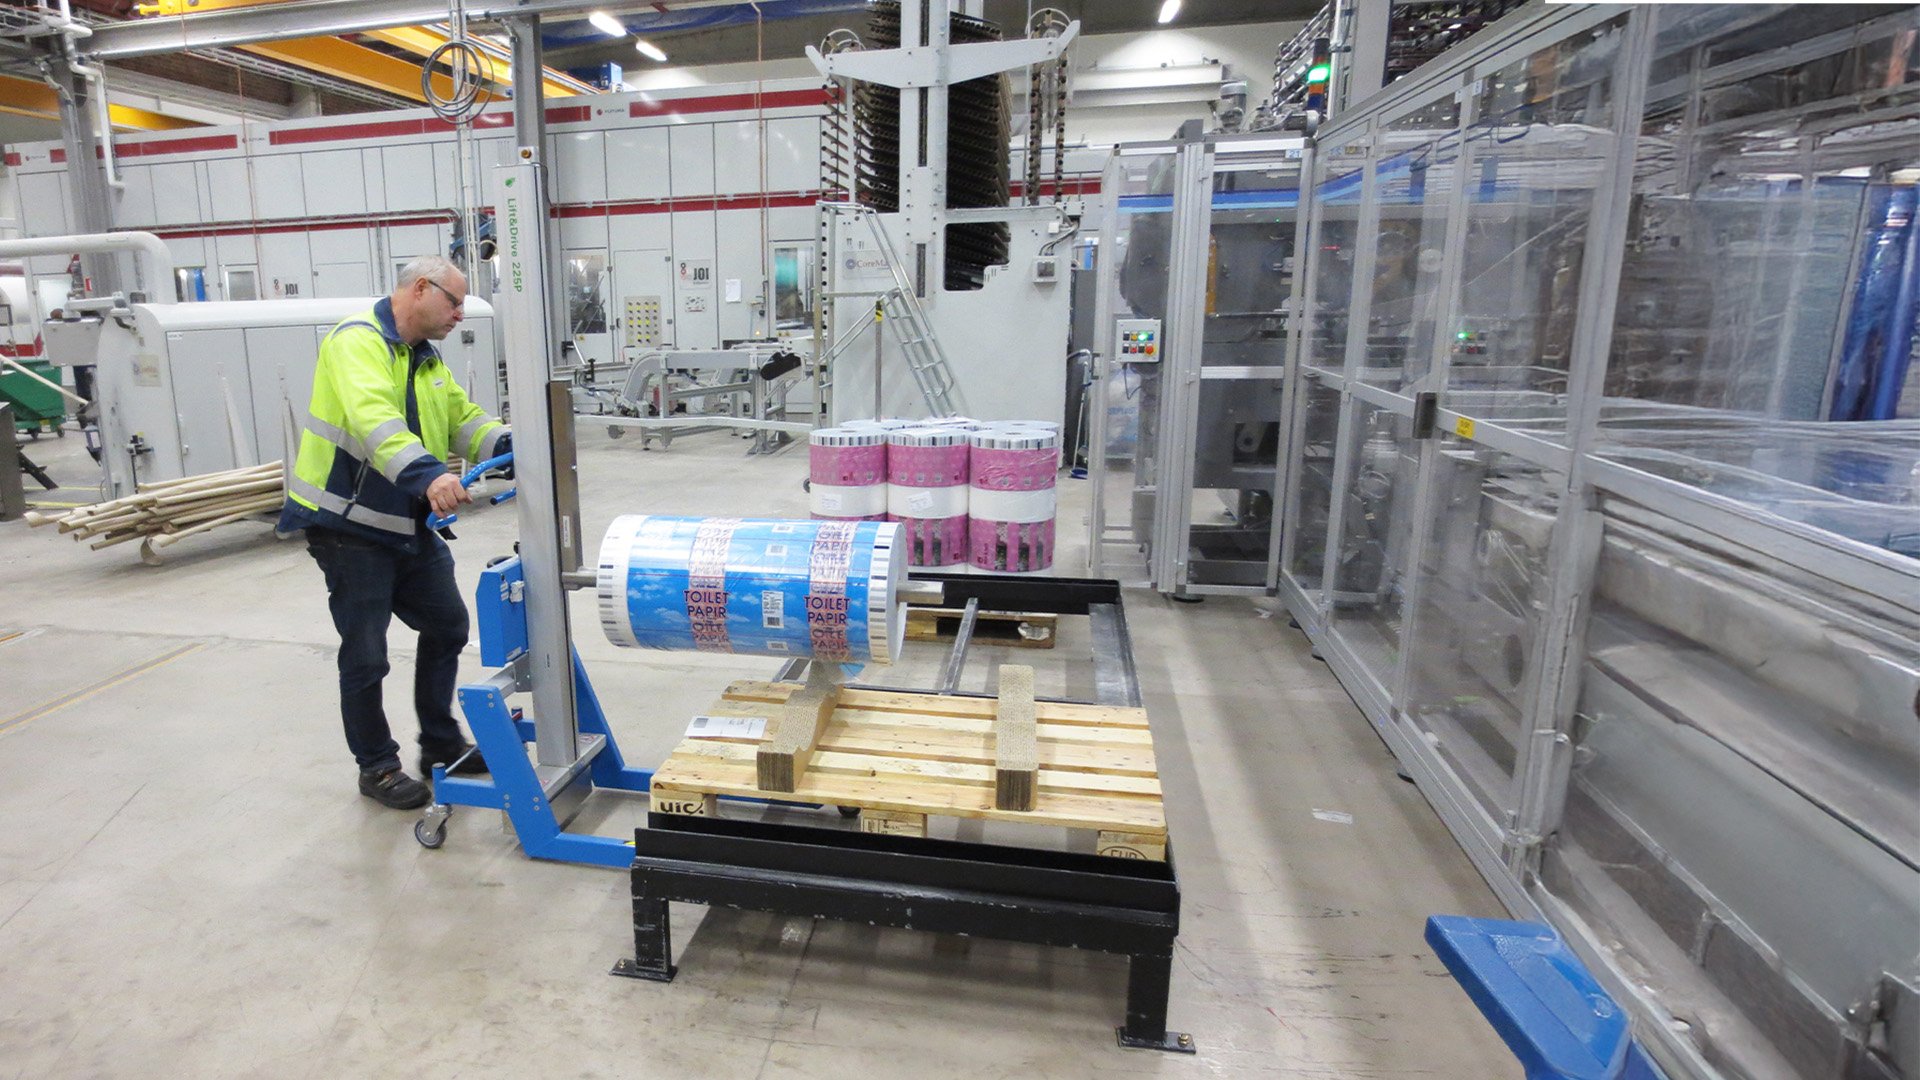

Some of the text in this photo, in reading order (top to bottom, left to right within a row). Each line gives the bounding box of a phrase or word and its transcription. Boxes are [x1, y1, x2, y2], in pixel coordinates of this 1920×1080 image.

[507, 198, 522, 293] Lift&Drive 225P
[684, 590, 729, 604] TOILET
[804, 596, 850, 610] TOILET
[687, 605, 727, 618] PAPIR
[807, 611, 848, 624] PAPIR
